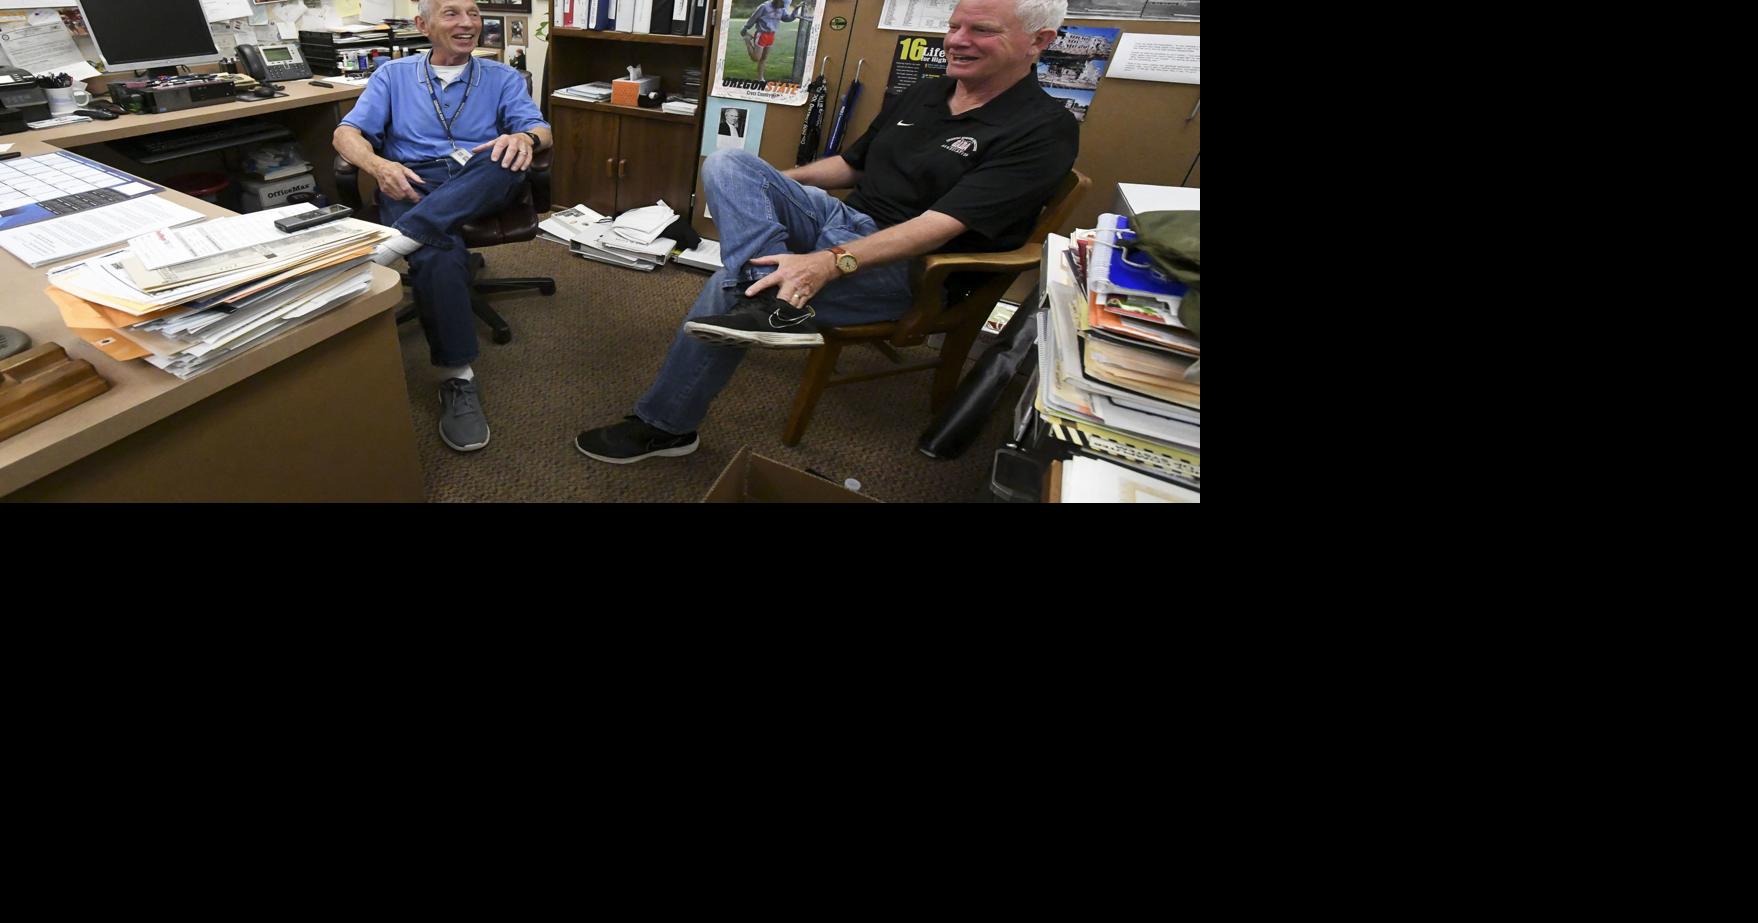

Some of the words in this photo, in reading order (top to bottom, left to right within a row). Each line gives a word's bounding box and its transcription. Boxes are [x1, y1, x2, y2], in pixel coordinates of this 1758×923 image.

[900, 37, 927, 61] 16
[922, 47, 945, 57] Life
[722, 79, 767, 91] OREGON
[764, 81, 800, 95] STATE
[267, 184, 309, 198] OfficeMax
